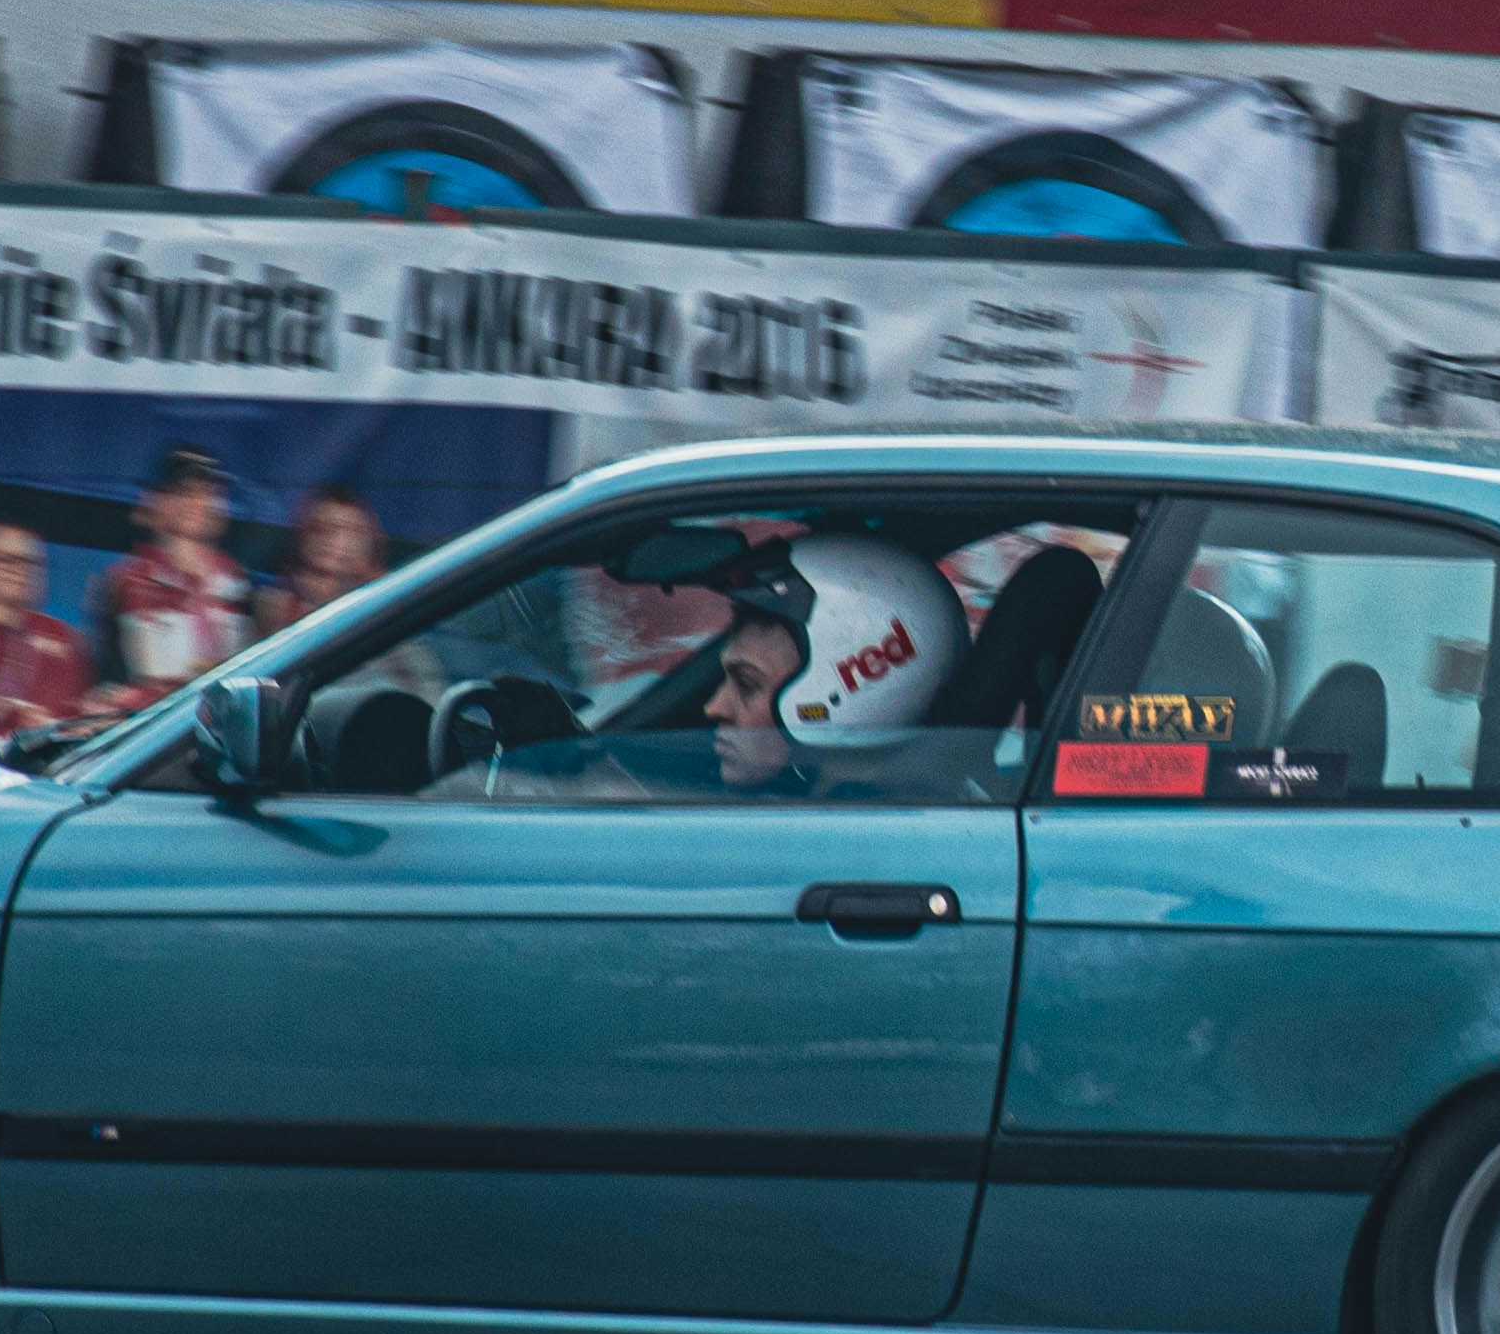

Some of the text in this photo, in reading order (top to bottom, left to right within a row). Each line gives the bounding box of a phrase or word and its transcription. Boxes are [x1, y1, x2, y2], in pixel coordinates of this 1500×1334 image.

[390, 267, 686, 392] ANKARA
[693, 290, 868, 405] 2016
[835, 614, 918, 694] red
